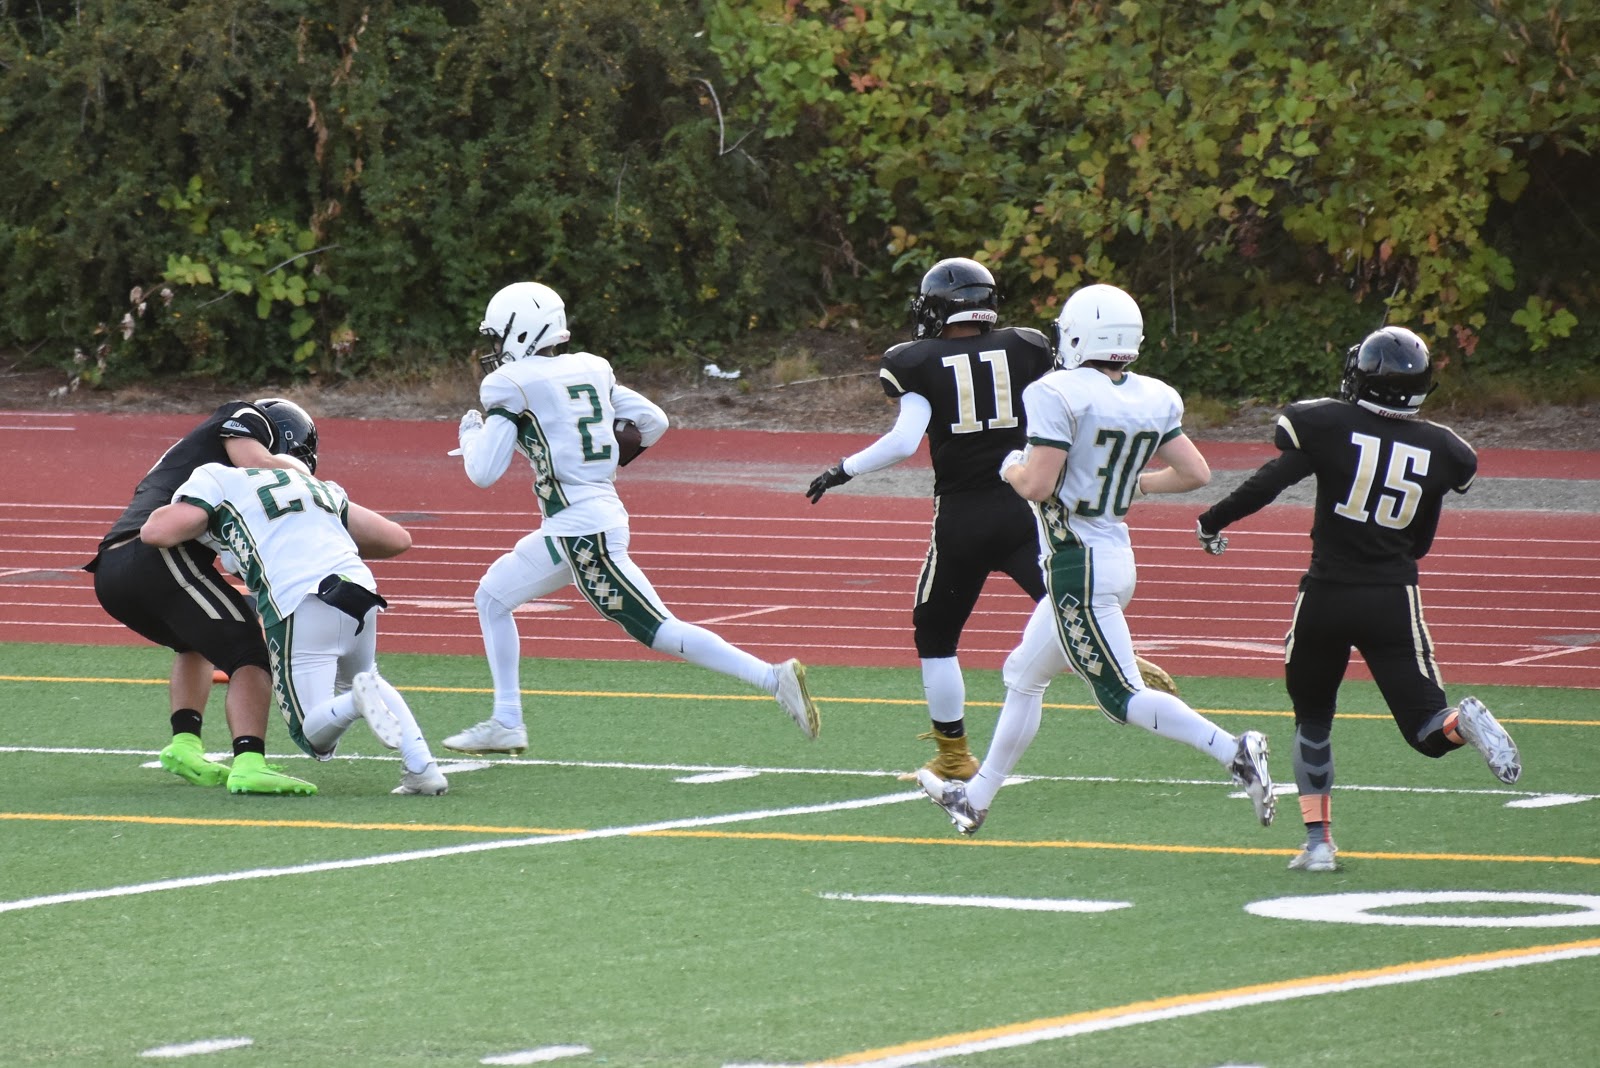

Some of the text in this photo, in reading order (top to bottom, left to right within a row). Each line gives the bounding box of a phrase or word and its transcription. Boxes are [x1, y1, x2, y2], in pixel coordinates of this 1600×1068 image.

[566, 383, 612, 464] 2
[941, 349, 1018, 434] 11
[1074, 428, 1160, 518] 30
[1334, 431, 1431, 530] 15
